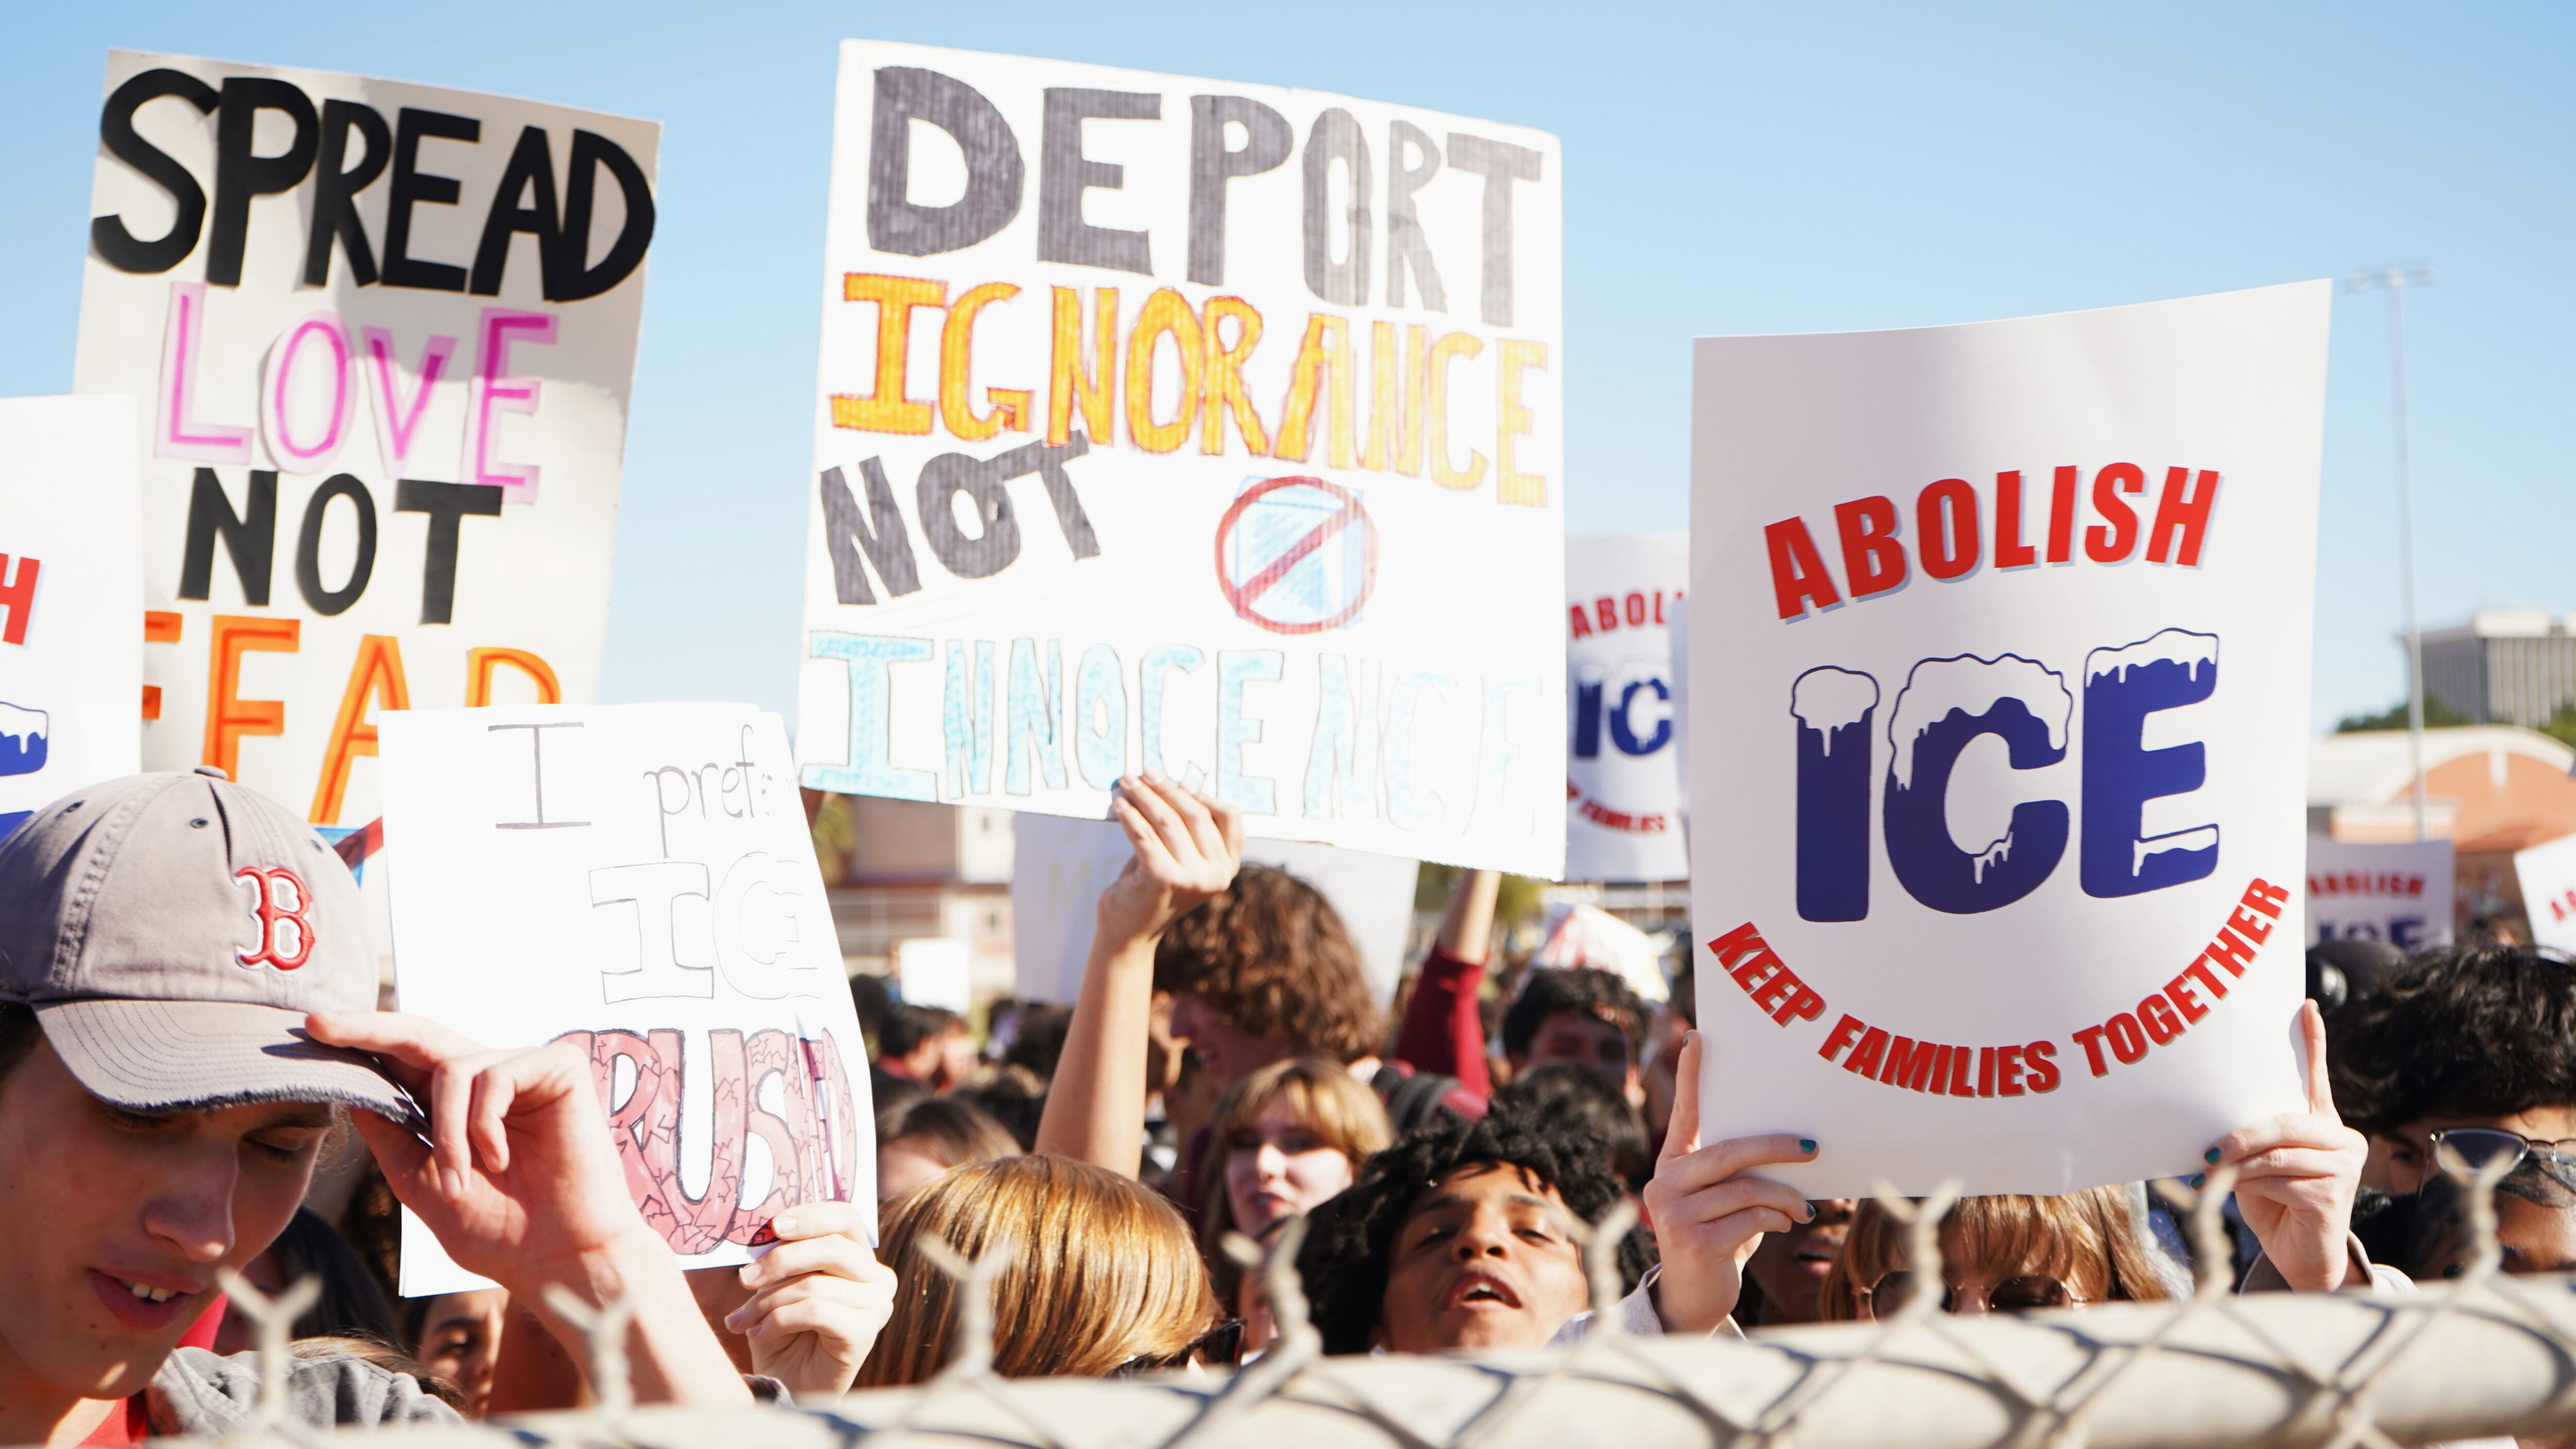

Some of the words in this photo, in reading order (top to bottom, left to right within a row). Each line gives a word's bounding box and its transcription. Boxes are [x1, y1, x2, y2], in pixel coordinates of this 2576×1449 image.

[92, 68, 655, 303] SPREAD
[866, 66, 1544, 327] DEPORT
[153, 282, 559, 505] LOVE
[828, 272, 1548, 508] IGNORANCE
[177, 467, 503, 625] NOT
[820, 429, 1100, 605] NOT
[1764, 462, 2221, 623] ABOLISH
[1570, 591, 1683, 641] ABOL
[1574, 660, 1673, 758] IC
[487, 722, 592, 829] I
[643, 723, 796, 858] pref
[799, 630, 1545, 836] INNOCENCE
[1790, 627, 2219, 922] ICE
[235, 866, 315, 974] B
[1707, 921, 1826, 1028] KEEP
[1818, 1013, 2061, 1098] FAMILIES
[2072, 878, 2290, 1078] TOGETHER
